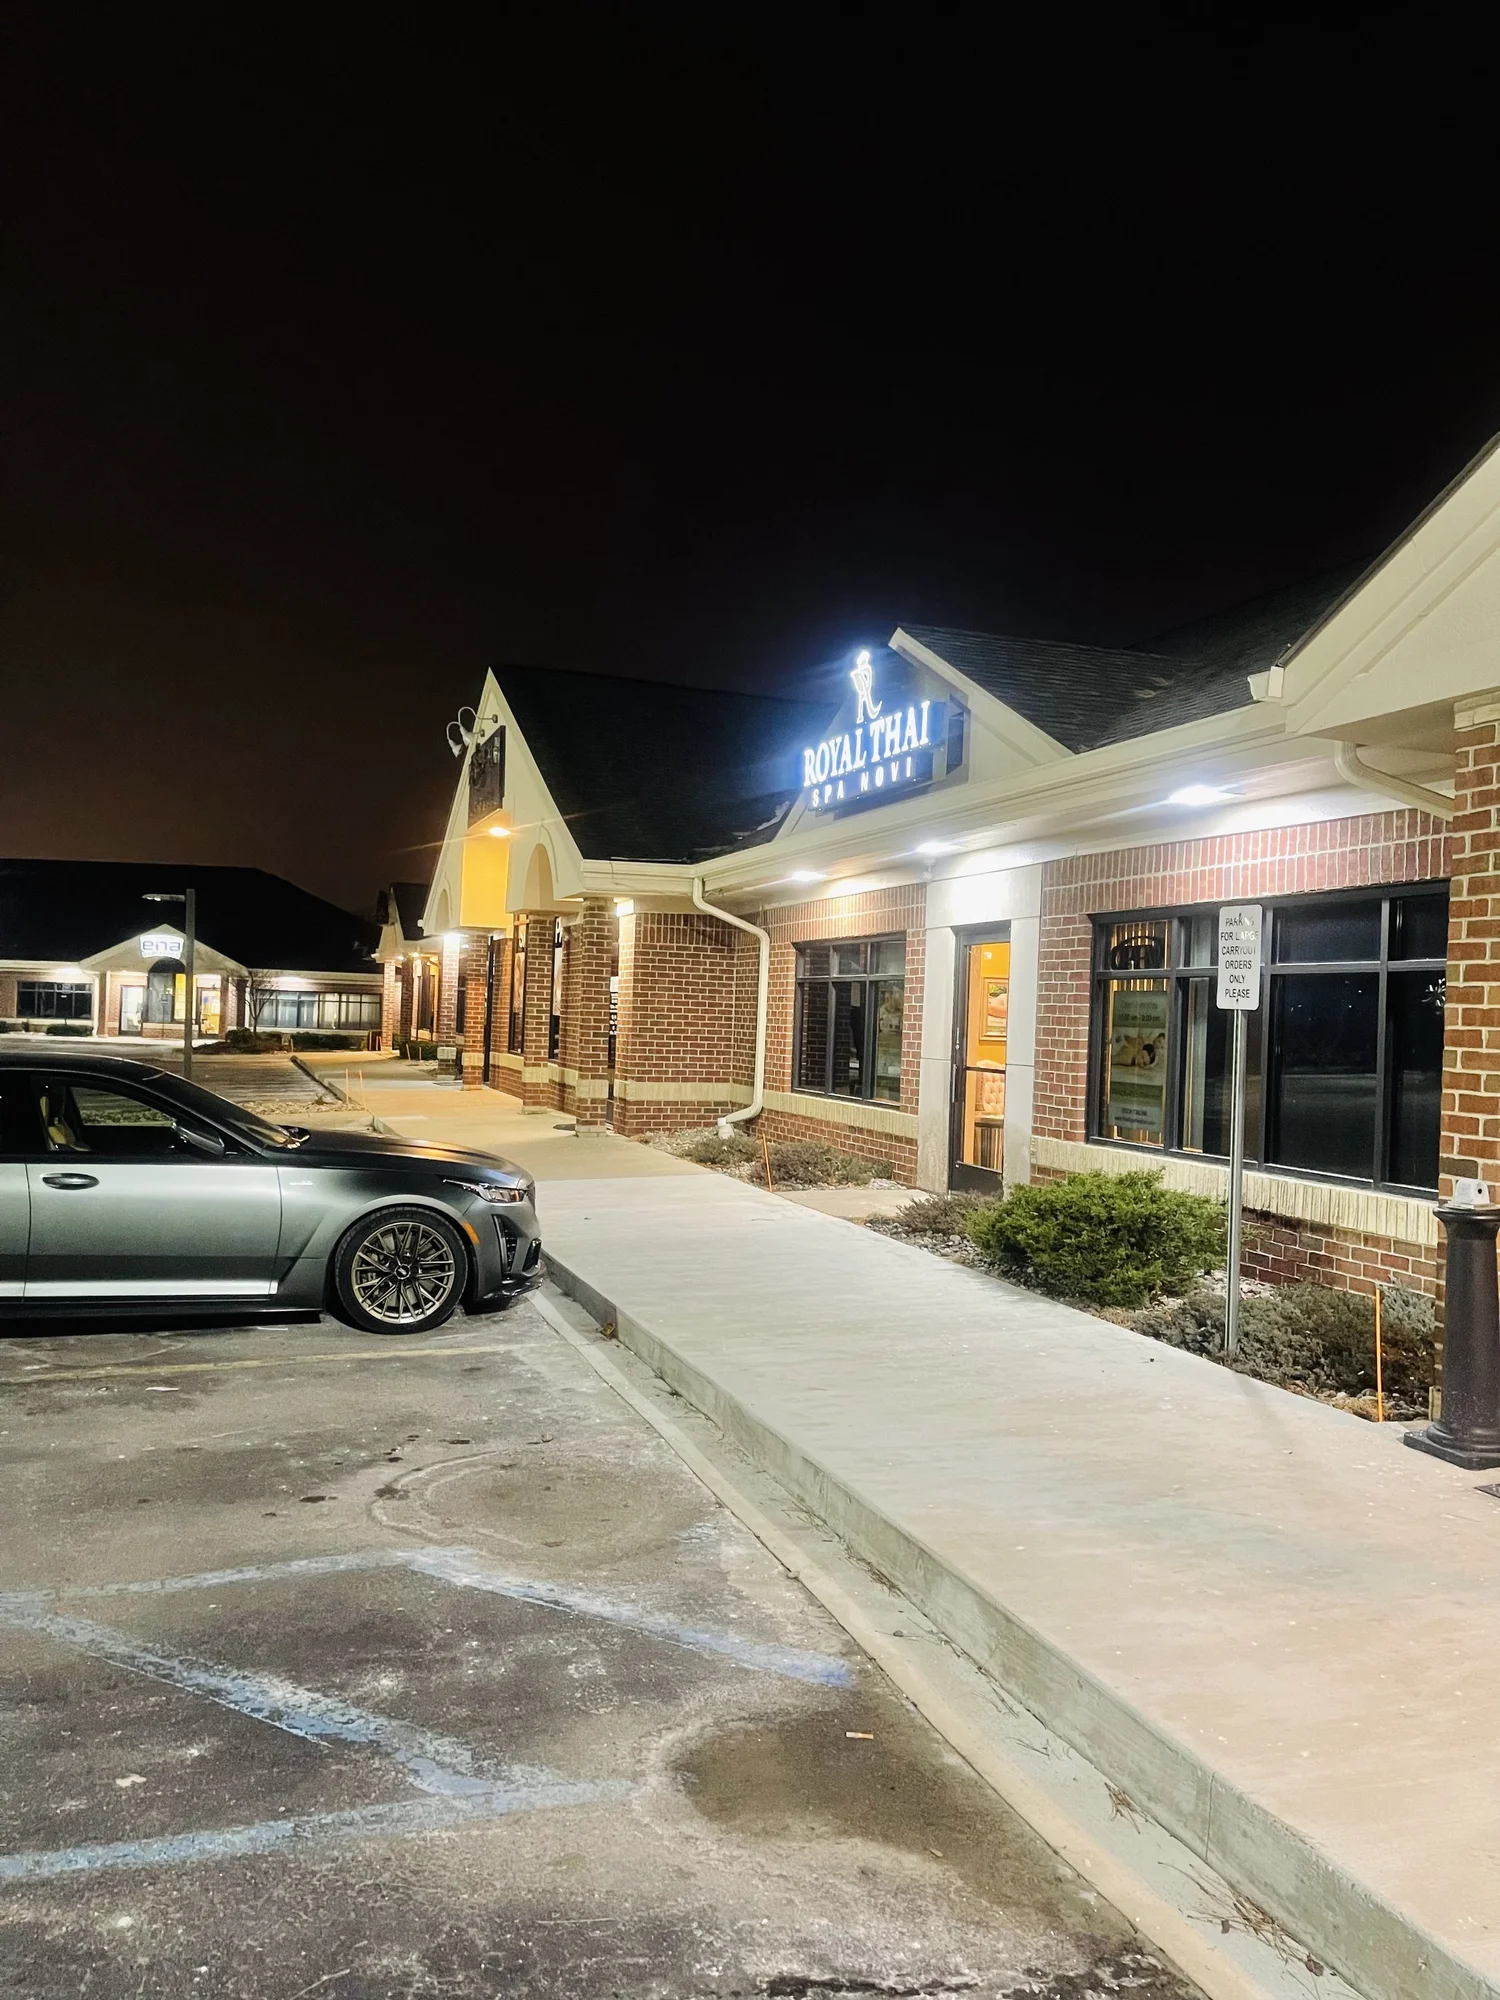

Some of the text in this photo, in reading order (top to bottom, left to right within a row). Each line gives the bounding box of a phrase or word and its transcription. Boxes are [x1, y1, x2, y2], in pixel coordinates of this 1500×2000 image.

[803, 700, 931, 787] ROYAL THAI
[812, 756, 912, 807] SPA NOVI
[1221, 932, 1234, 941] FOR
[1221, 946, 1256, 955] CARRYOUT
[1225, 960, 1252, 969] ORDERS
[1229, 974, 1246, 984] ONLY
[1225, 988, 1251, 998] PLEASE
